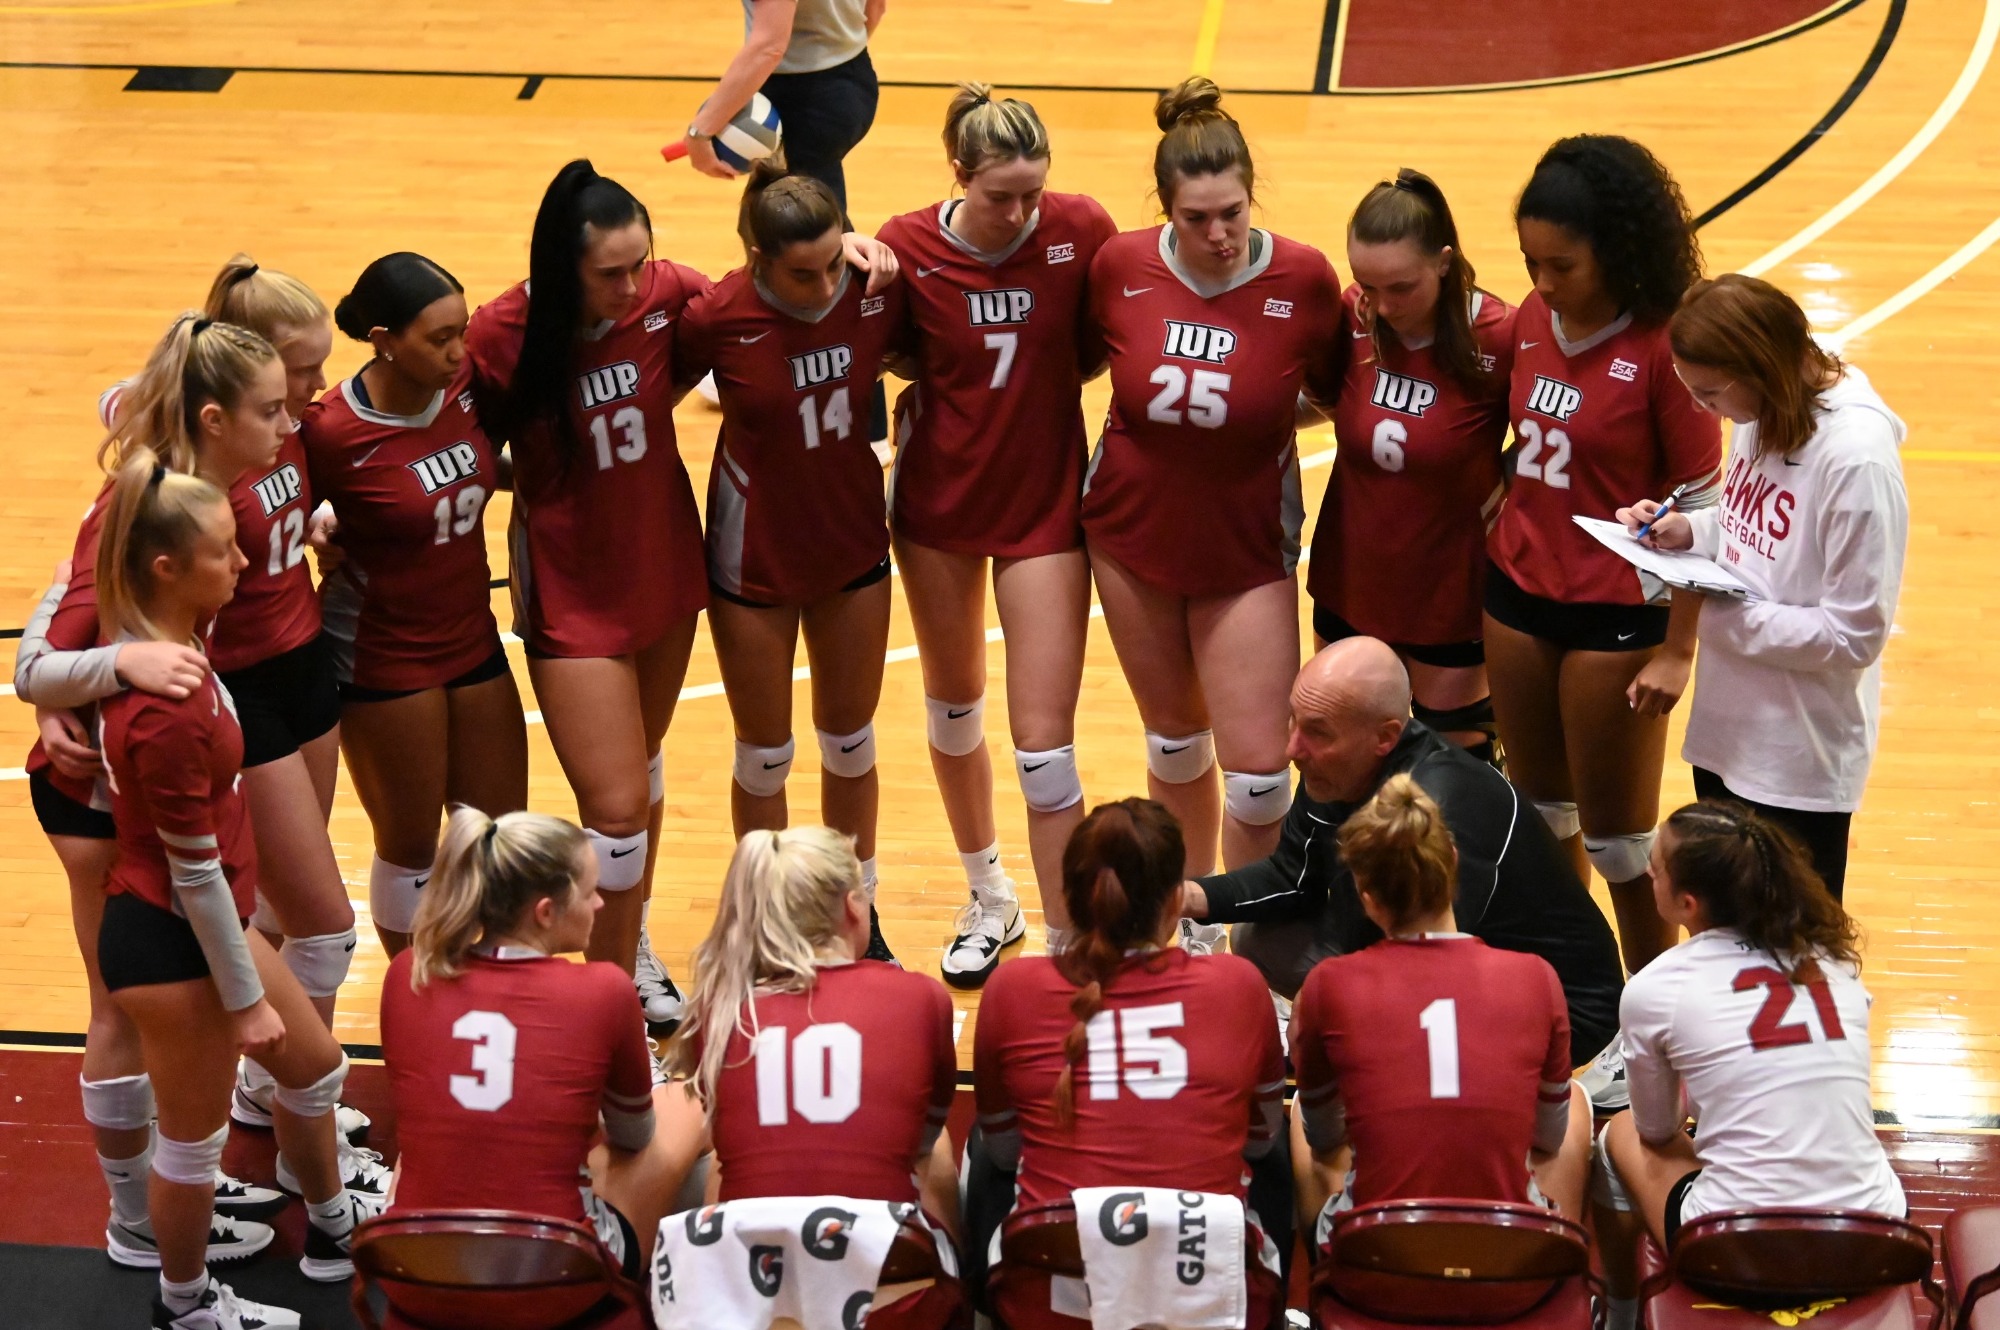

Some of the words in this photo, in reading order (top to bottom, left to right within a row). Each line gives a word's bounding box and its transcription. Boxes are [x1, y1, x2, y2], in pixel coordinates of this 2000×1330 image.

[1046, 246, 1075, 260] PSAC
[643, 314, 668, 328] PSAC
[860, 299, 885, 312] PSAC
[966, 290, 1033, 325] IUP
[1264, 303, 1293, 314] PSAC
[787, 344, 852, 390] IUP
[984, 332, 1018, 389] 7
[1164, 321, 1236, 363] IUP
[576, 361, 640, 409] IUP
[1147, 364, 1231, 429] 25
[1371, 370, 1437, 416] IUP
[1610, 363, 1637, 378] PSAC
[798, 386, 852, 450] 14
[1526, 376, 1583, 422] IUP
[589, 406, 647, 470] 13
[1372, 418, 1408, 473] 6
[1516, 417, 1572, 489] 22
[252, 464, 302, 516] IUP
[409, 442, 480, 494] IUP
[433, 484, 486, 545] 19
[1720, 457, 1795, 541] AWKS
[268, 508, 305, 575] 12
[1720, 510, 1776, 561] LEYBALL
[1731, 958, 1846, 1053] 21
[450, 1010, 517, 1112] 3
[755, 1022, 862, 1126] 10
[1086, 1001, 1188, 1100] 15
[1420, 998, 1460, 1098] 1
[1099, 1192, 1148, 1246] G
